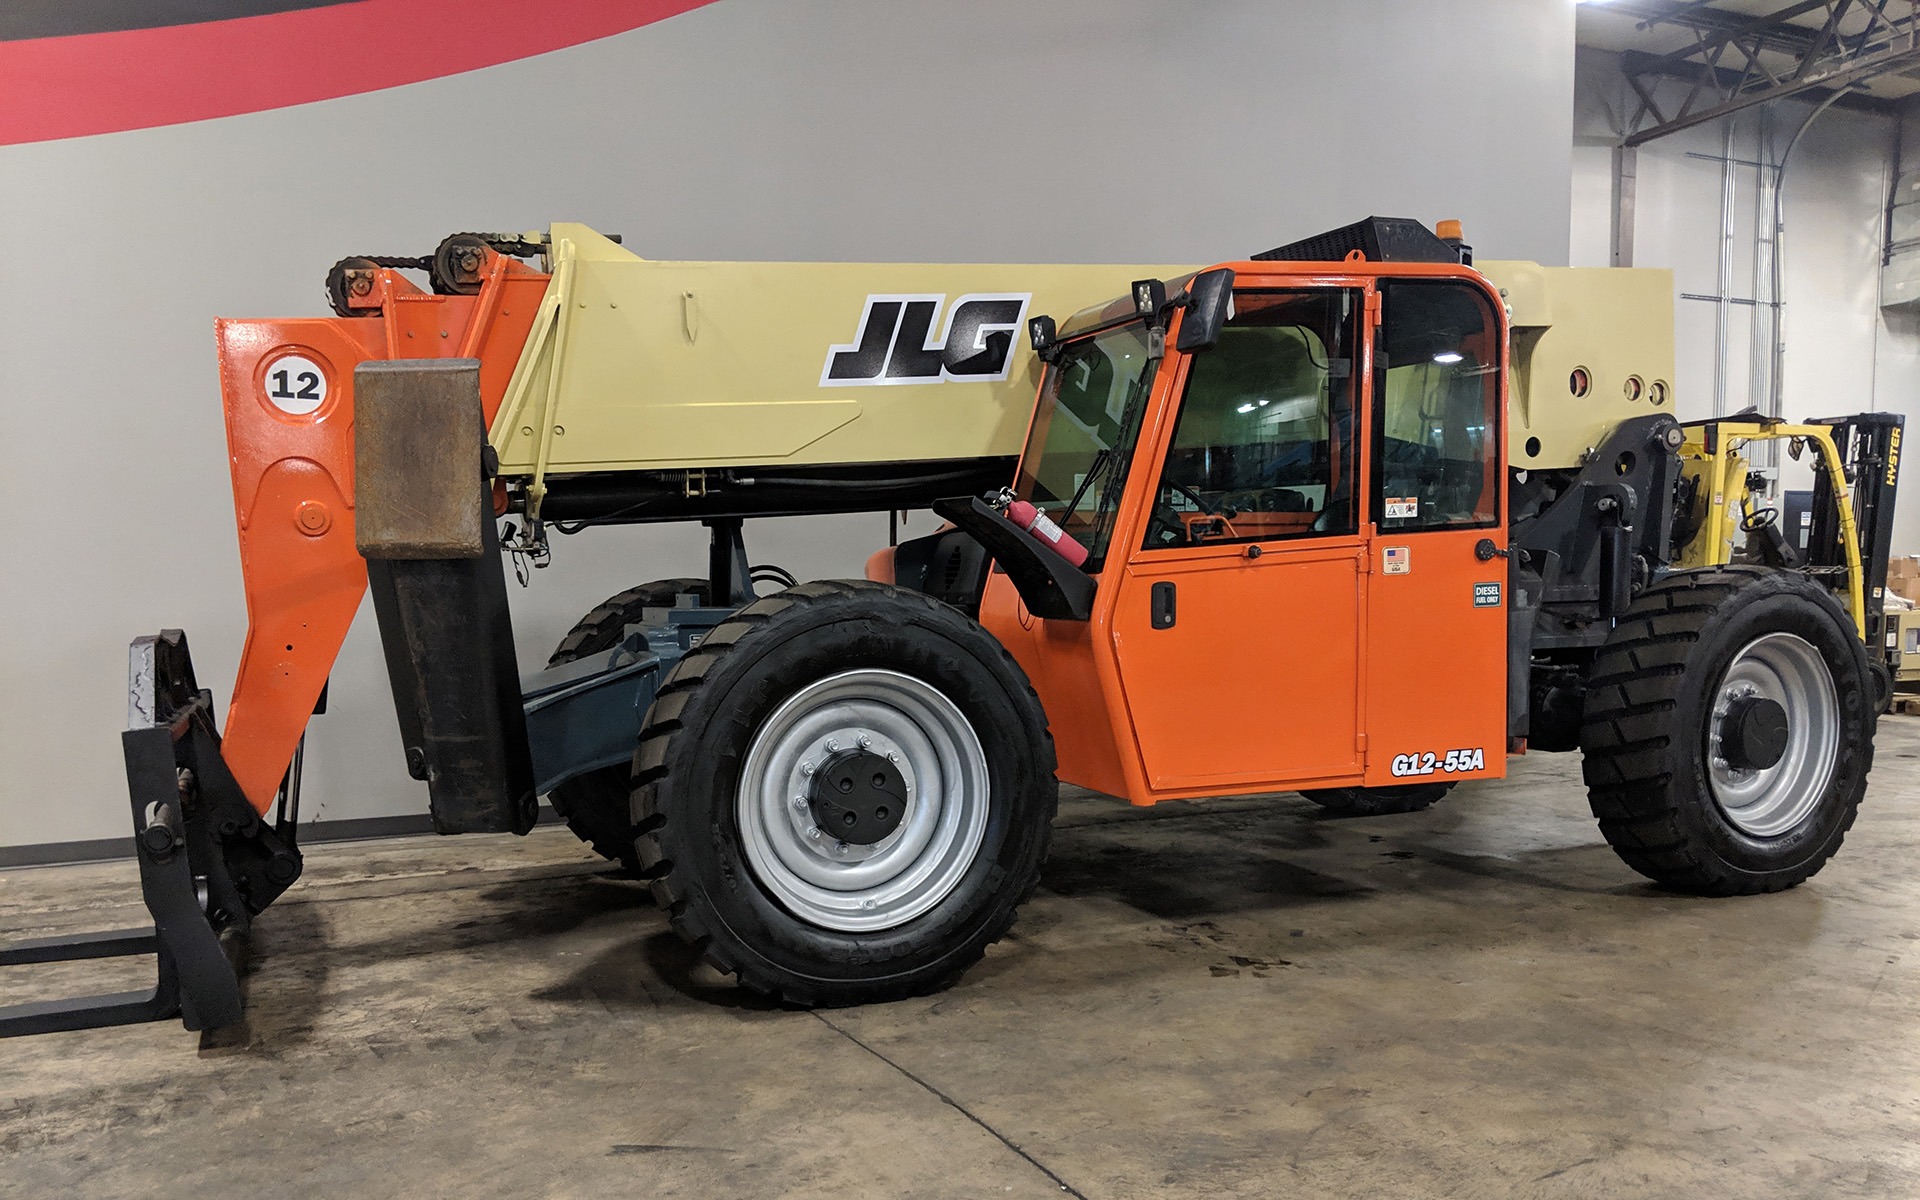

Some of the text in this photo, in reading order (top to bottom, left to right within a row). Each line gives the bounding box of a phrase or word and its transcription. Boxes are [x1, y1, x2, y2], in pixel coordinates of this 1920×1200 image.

[821, 294, 1031, 385] JLG
[272, 369, 320, 401] 12
[1886, 426, 1902, 487] HYSTER
[1476, 586, 1499, 596] DIESEL
[1391, 748, 1485, 777] G12-55A
